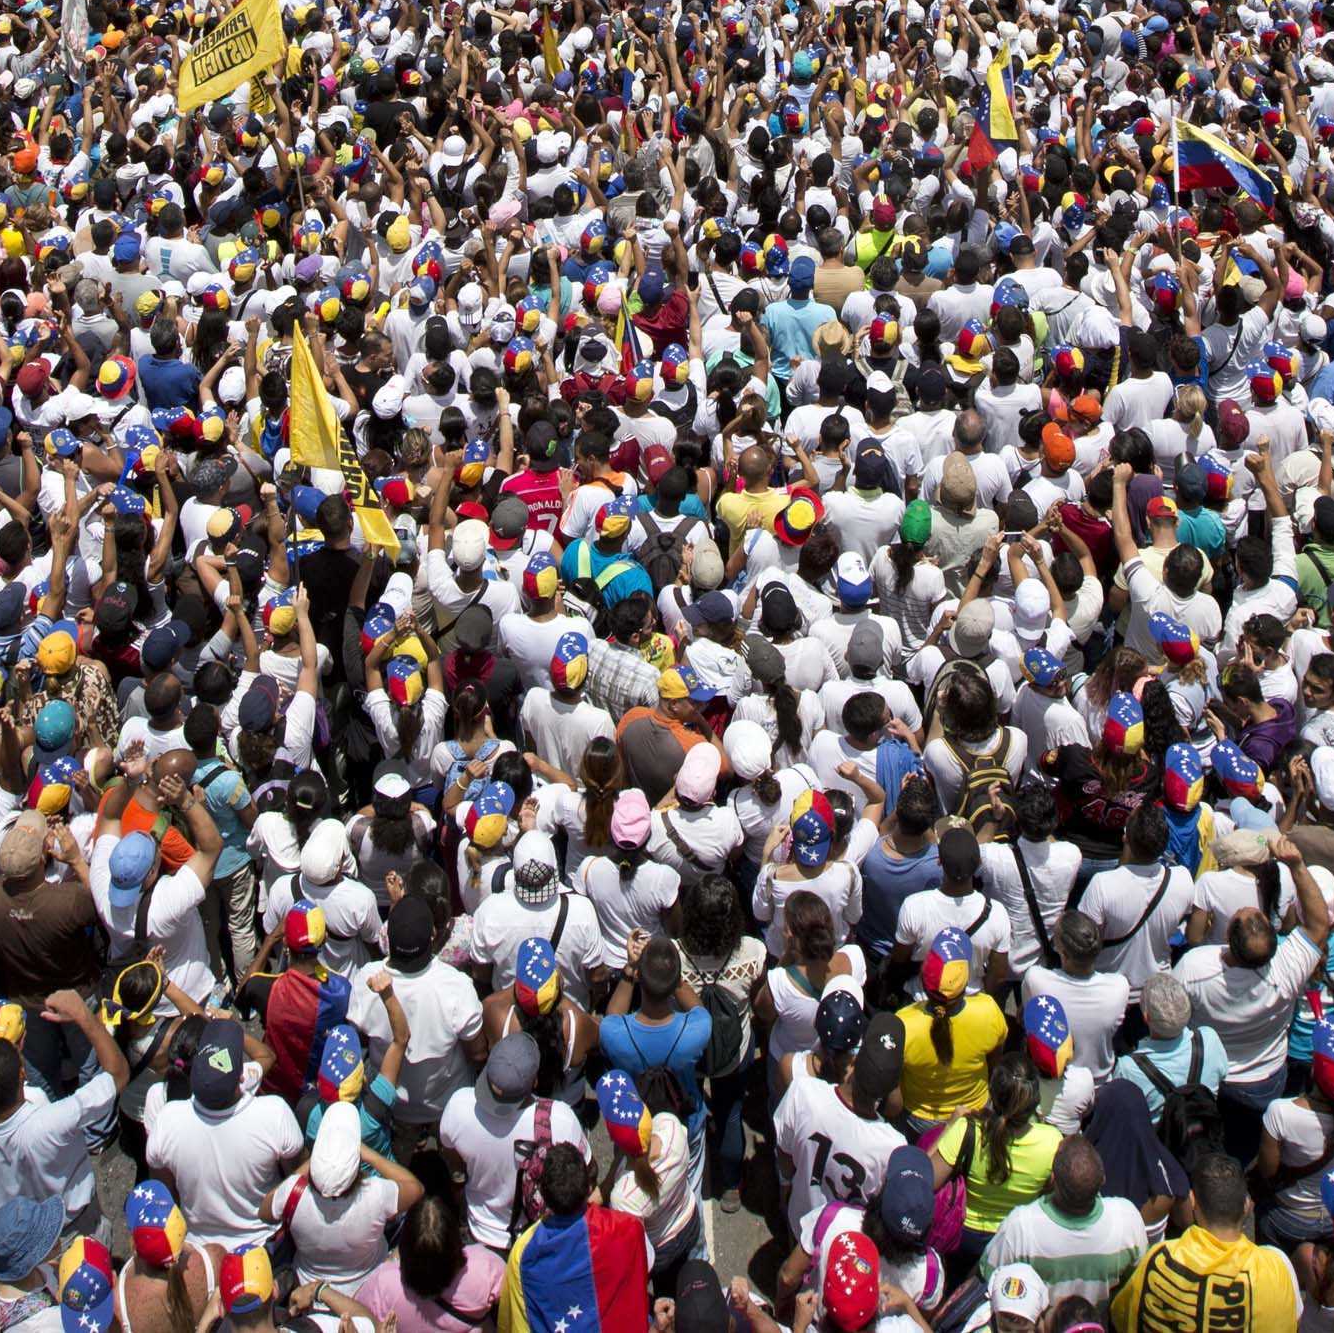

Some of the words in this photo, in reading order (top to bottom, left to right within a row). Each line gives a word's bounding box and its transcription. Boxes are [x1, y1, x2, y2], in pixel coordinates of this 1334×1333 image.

[537, 513, 558, 535] 7
[808, 1131, 867, 1203] 13
[1144, 1253, 1201, 1333] JUS
[1209, 1280, 1245, 1333] PR
